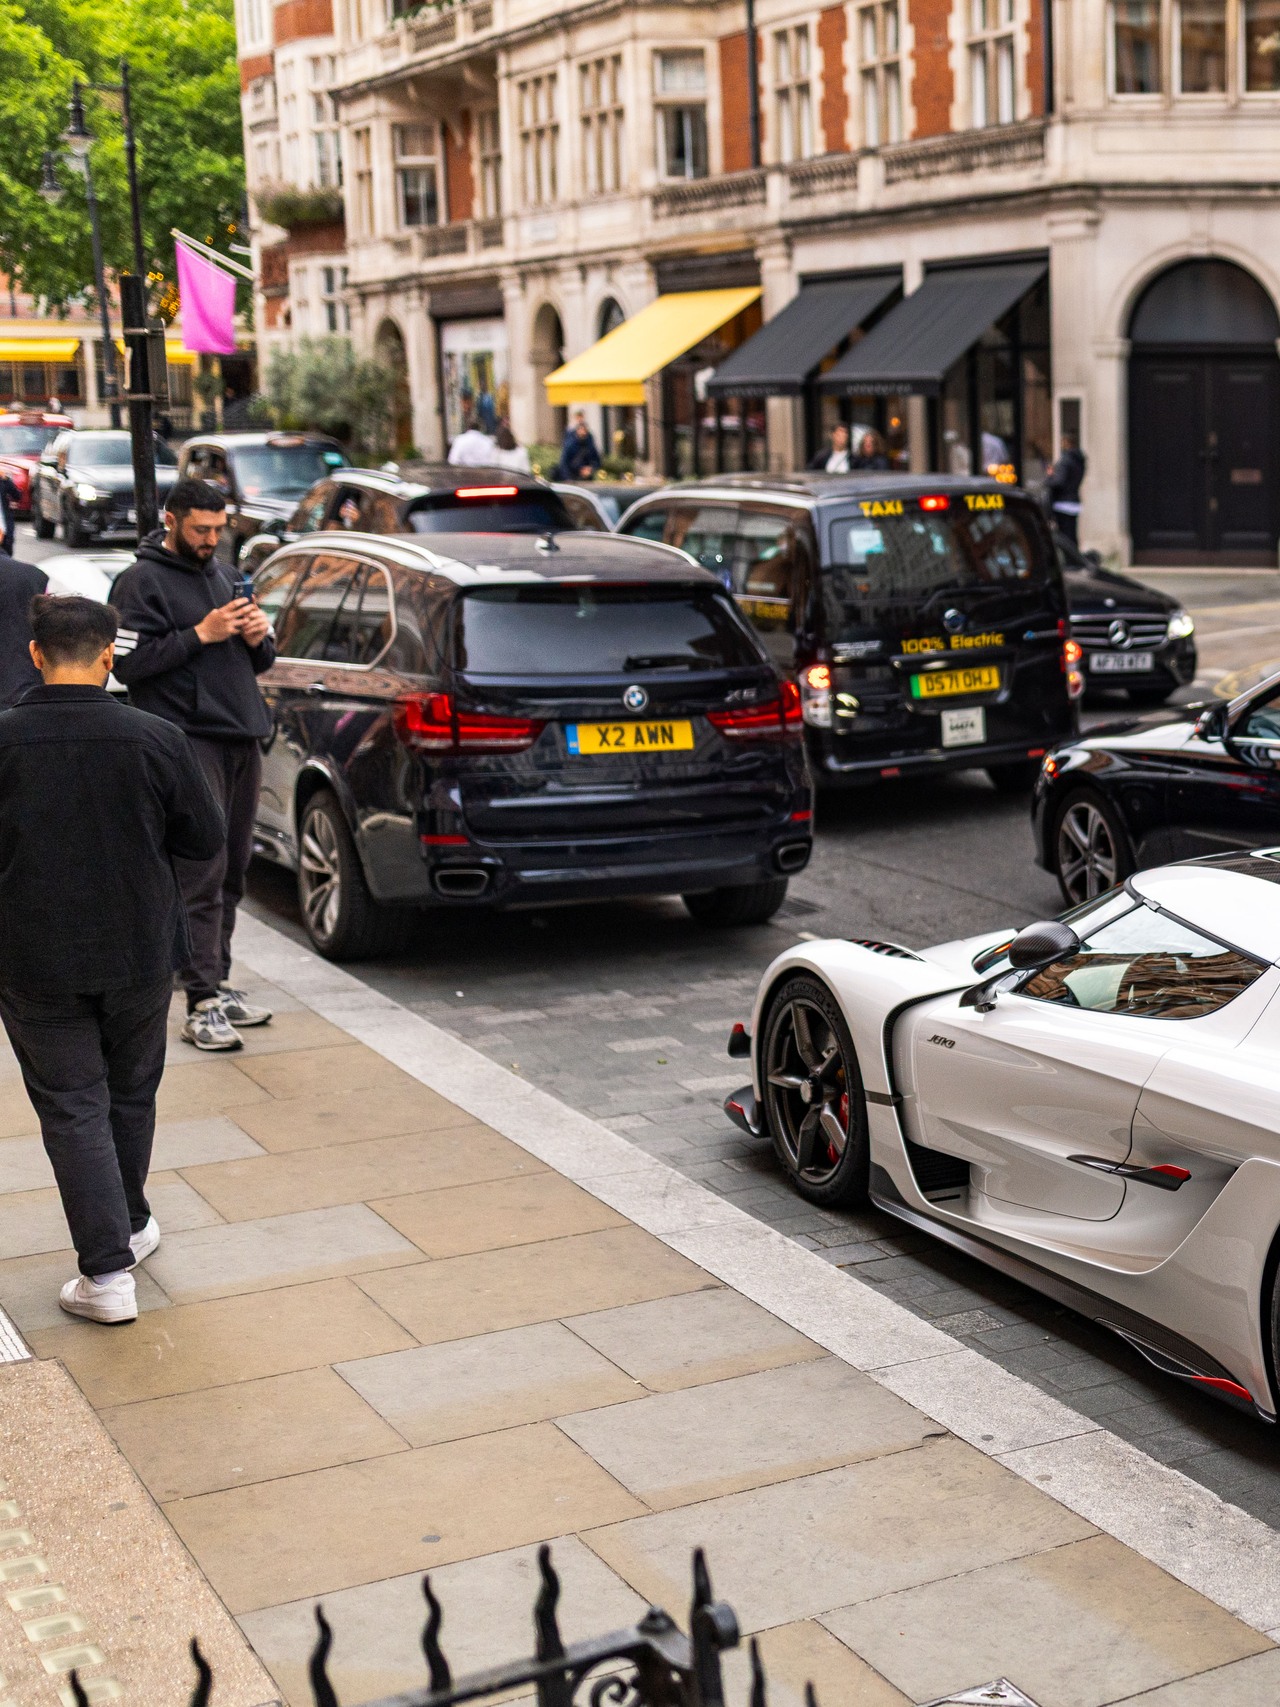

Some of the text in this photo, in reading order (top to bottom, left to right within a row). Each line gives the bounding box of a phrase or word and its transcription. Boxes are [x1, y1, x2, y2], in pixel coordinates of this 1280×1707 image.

[859, 499, 904, 518] TAXI
[963, 493, 1005, 511] TAXI
[901, 635, 945, 654] 100%
[950, 632, 1005, 650] Electric
[925, 673, 960, 692] DS71
[597, 724, 675, 747] X2 AWN
